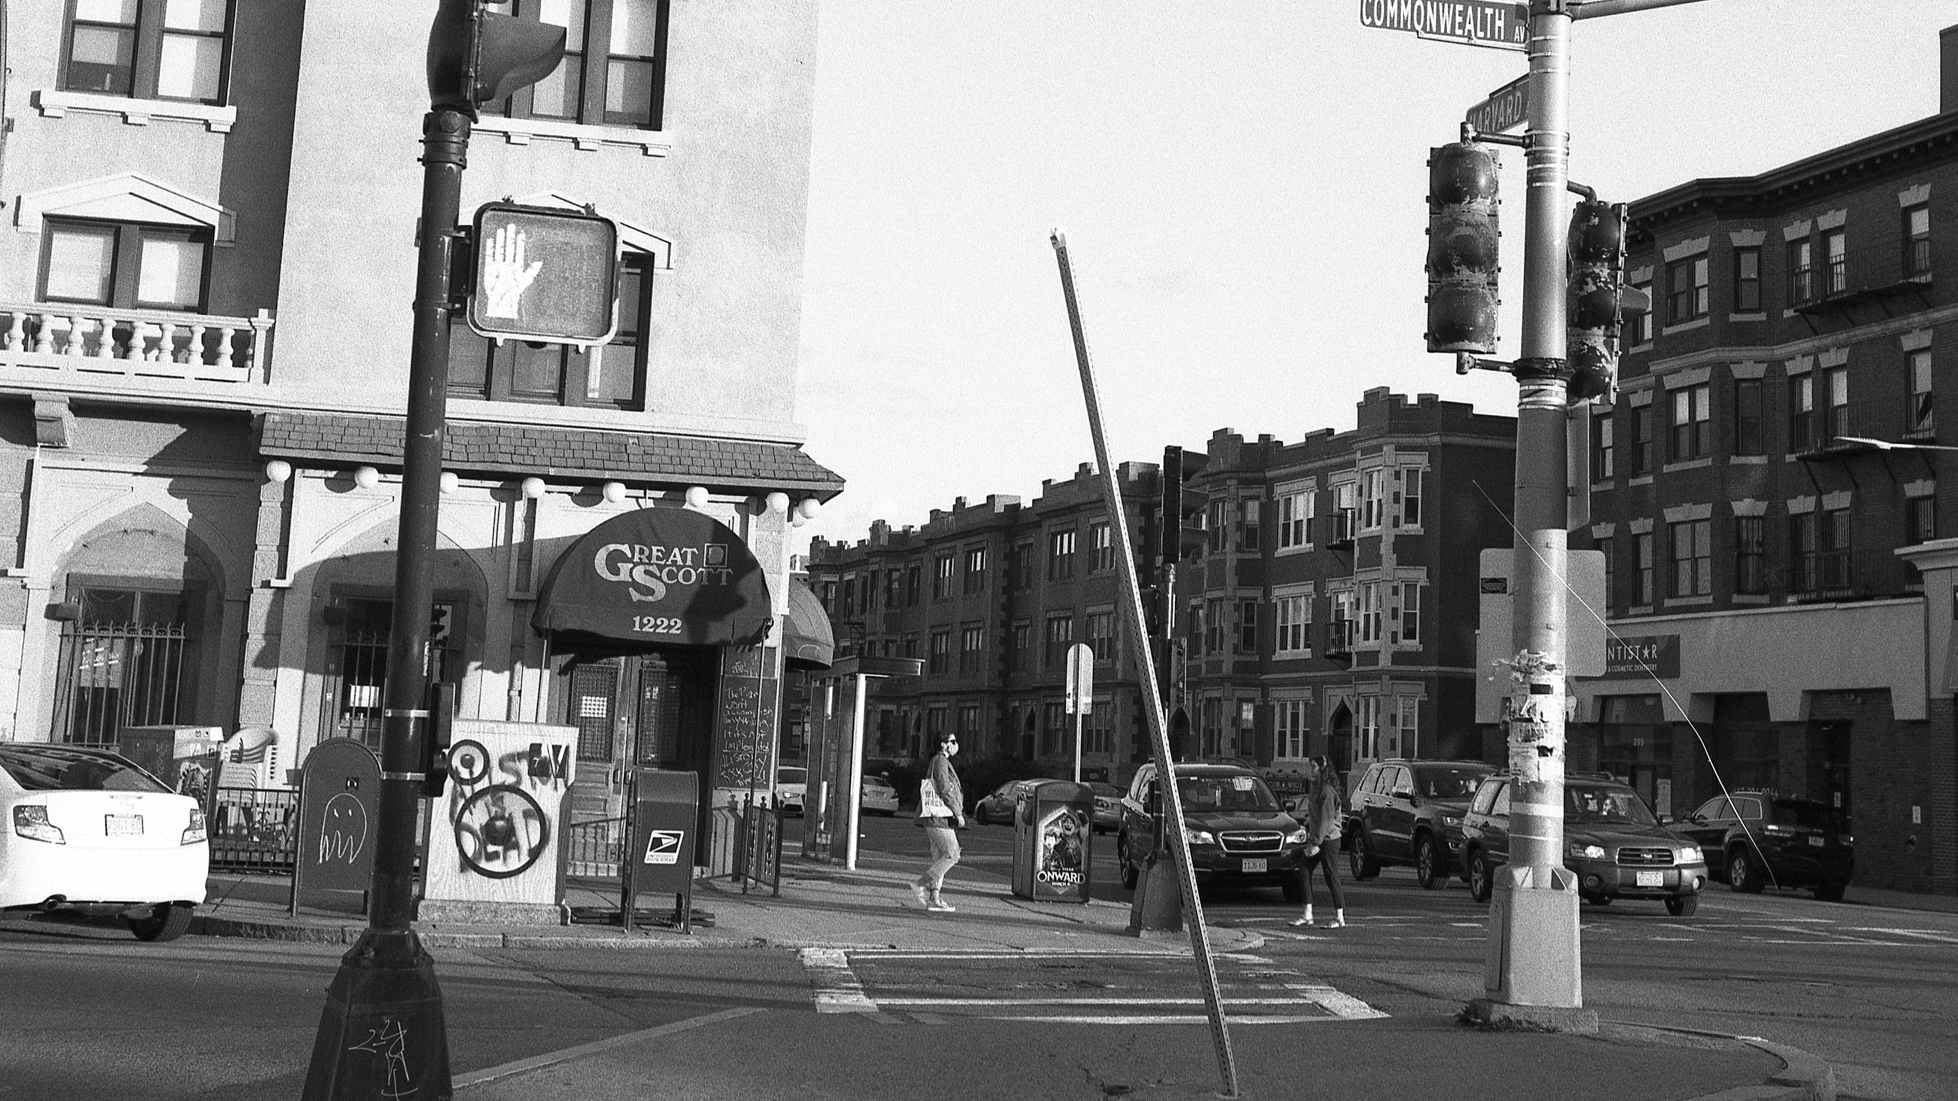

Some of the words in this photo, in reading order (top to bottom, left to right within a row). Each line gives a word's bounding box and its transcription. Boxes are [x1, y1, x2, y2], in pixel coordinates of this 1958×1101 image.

[1361, 0, 1505, 40] COMMONWEALTH
[1469, 91, 1522, 133] HARVARD
[594, 543, 698, 582] GREAT
[628, 564, 734, 602] SCOTT
[632, 615, 682, 634] 1222
[1611, 664, 1634, 672] COSMETIC
[1634, 663, 1658, 672] DENTRY
[1036, 870, 1086, 885] ONWARD
